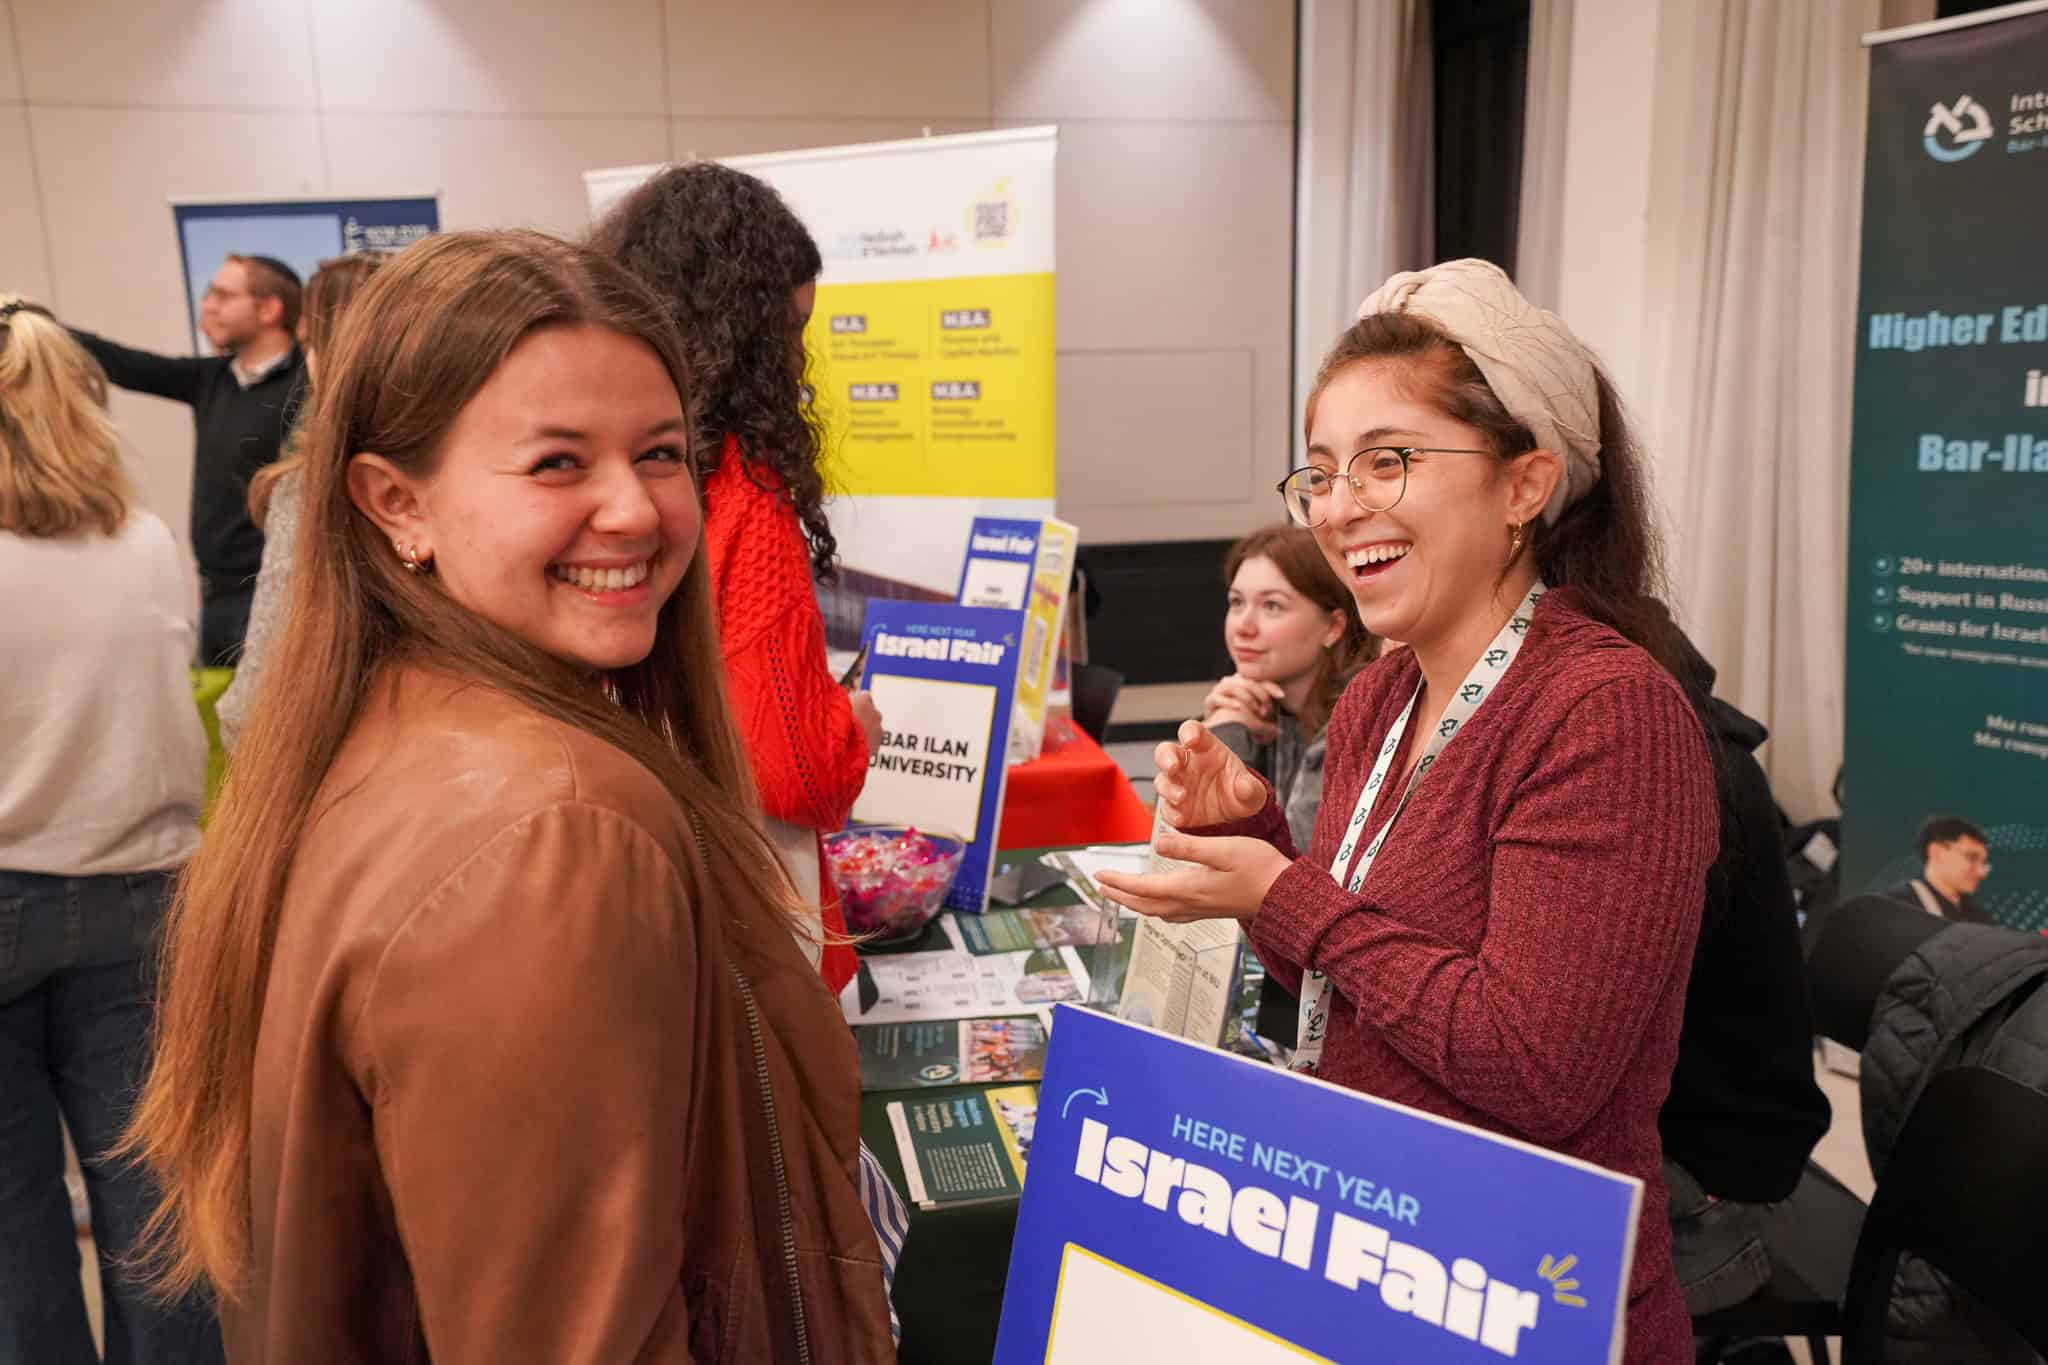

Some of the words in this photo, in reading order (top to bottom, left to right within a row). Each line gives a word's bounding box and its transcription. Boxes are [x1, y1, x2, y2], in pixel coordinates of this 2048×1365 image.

[2011, 92, 2048, 112] Int
[1869, 310, 1993, 351] Higher
[1897, 585, 1970, 608] Support
[1975, 593, 1996, 608] in
[1896, 614, 1955, 635] Grants
[1959, 619, 1988, 638] for
[875, 632, 950, 661] Israel
[950, 639, 1005, 666] Fair
[880, 731, 918, 751] BAR
[924, 736, 968, 758] ILAN
[1172, 1114, 1244, 1163] HERE
[1252, 1141, 1329, 1191] NEXT
[1336, 1169, 1421, 1226] YEAR
[1074, 1116, 1319, 1271] Israel
[1324, 1212, 1540, 1358] Fair
